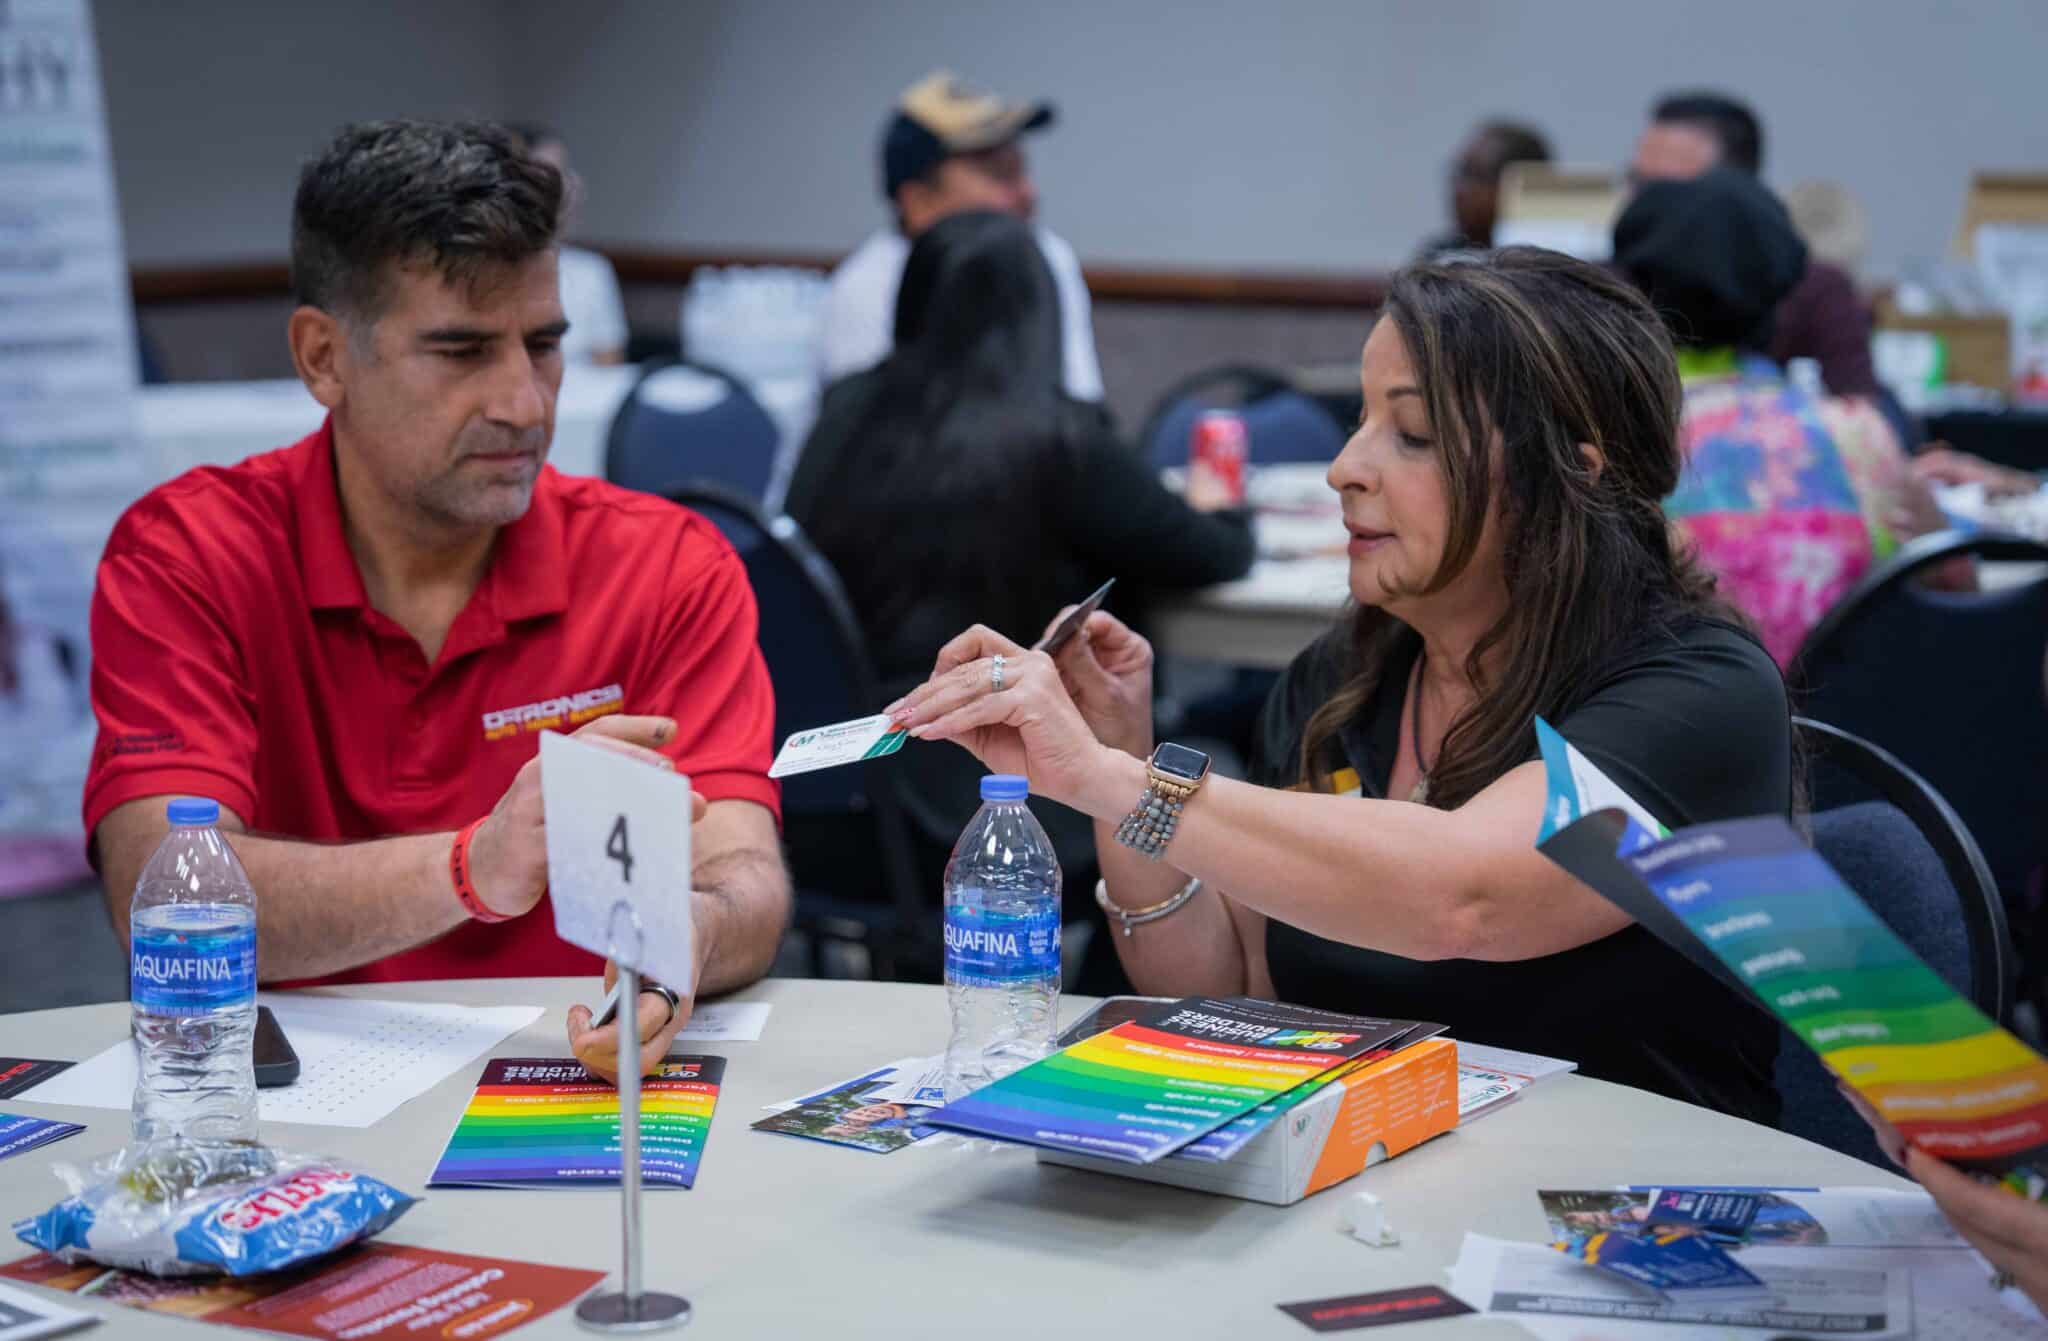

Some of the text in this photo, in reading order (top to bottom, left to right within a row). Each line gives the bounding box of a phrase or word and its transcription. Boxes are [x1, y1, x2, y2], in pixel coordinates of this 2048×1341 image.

[605, 814, 634, 884] 4
[944, 922, 1019, 958] QUAFINA
[134, 954, 232, 984] AQUAFINA
[1169, 1016, 1269, 1039] BUSINESS
[591, 1112, 658, 1121] haers
[603, 1146, 689, 1157] broches
[611, 1135, 693, 1145] postcas
